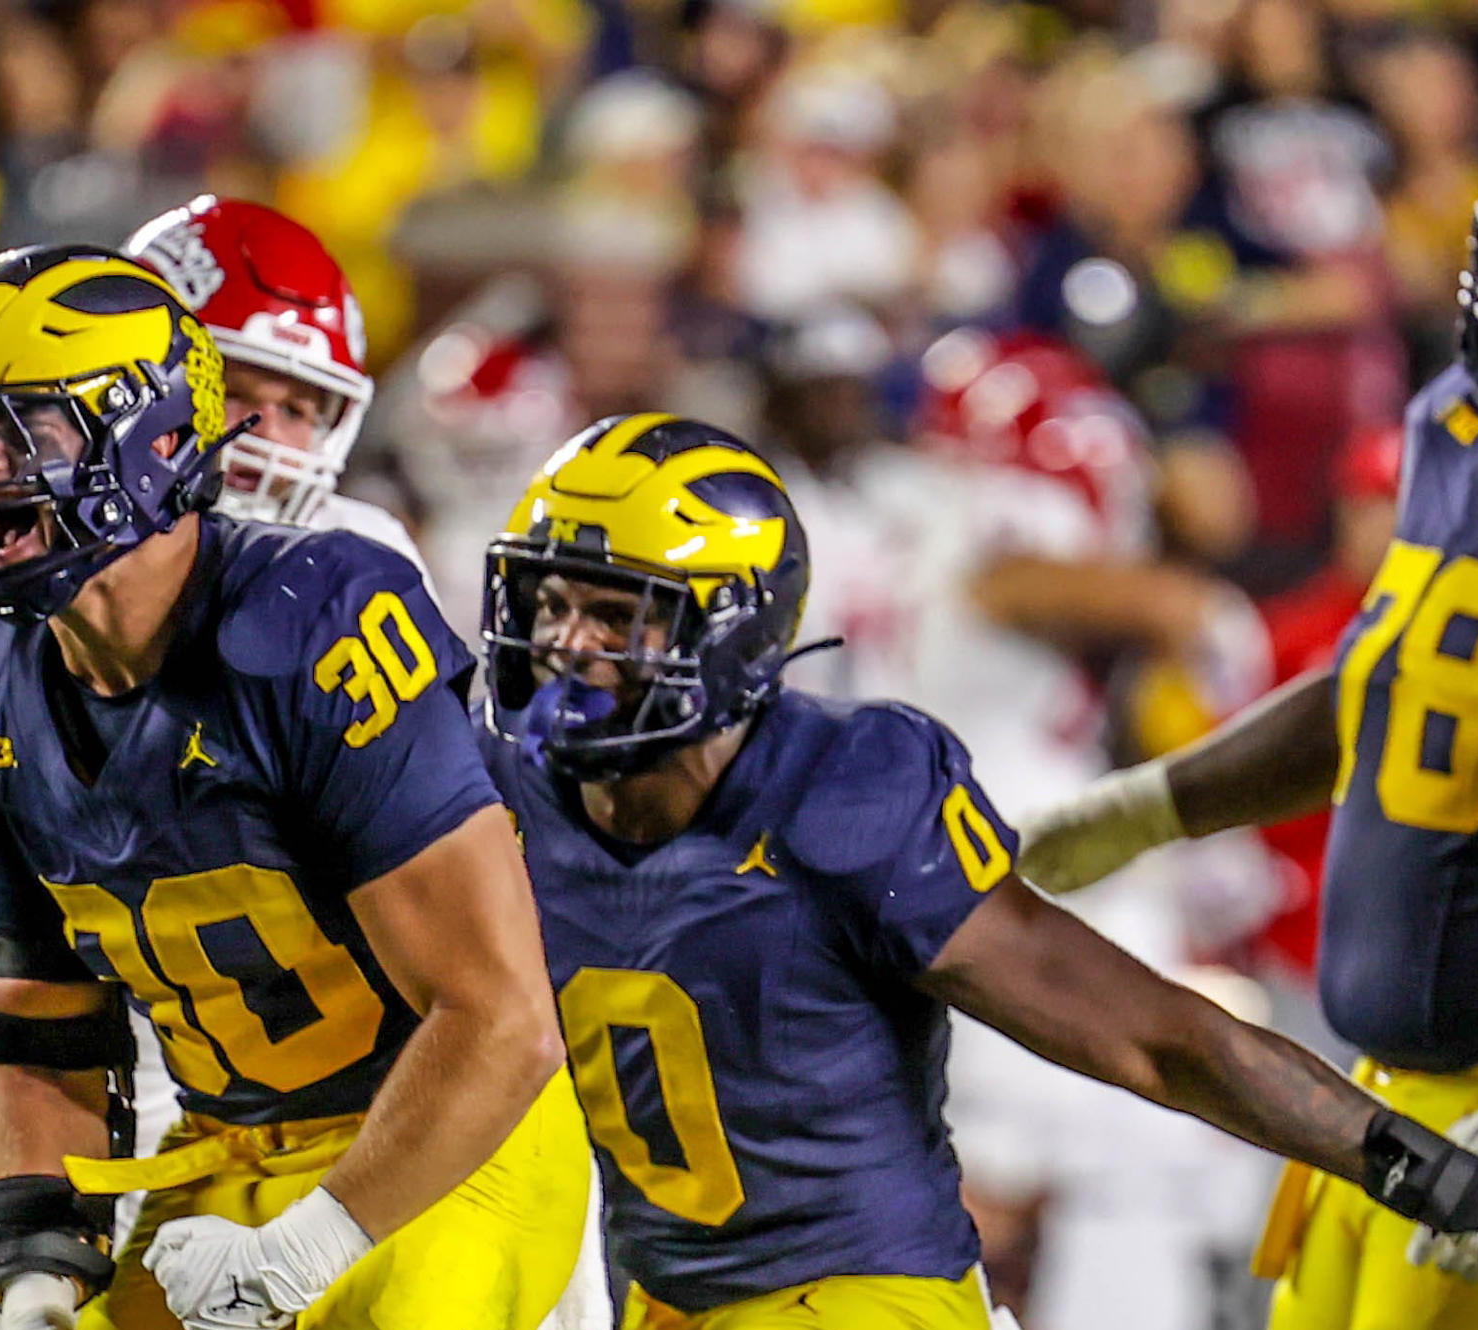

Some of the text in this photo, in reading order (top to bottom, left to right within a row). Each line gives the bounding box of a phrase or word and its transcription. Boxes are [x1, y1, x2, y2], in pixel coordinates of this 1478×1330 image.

[314, 589, 437, 749] 30
[942, 784, 1011, 893] 0
[37, 861, 386, 1096] 30
[559, 966, 746, 1227] 0
